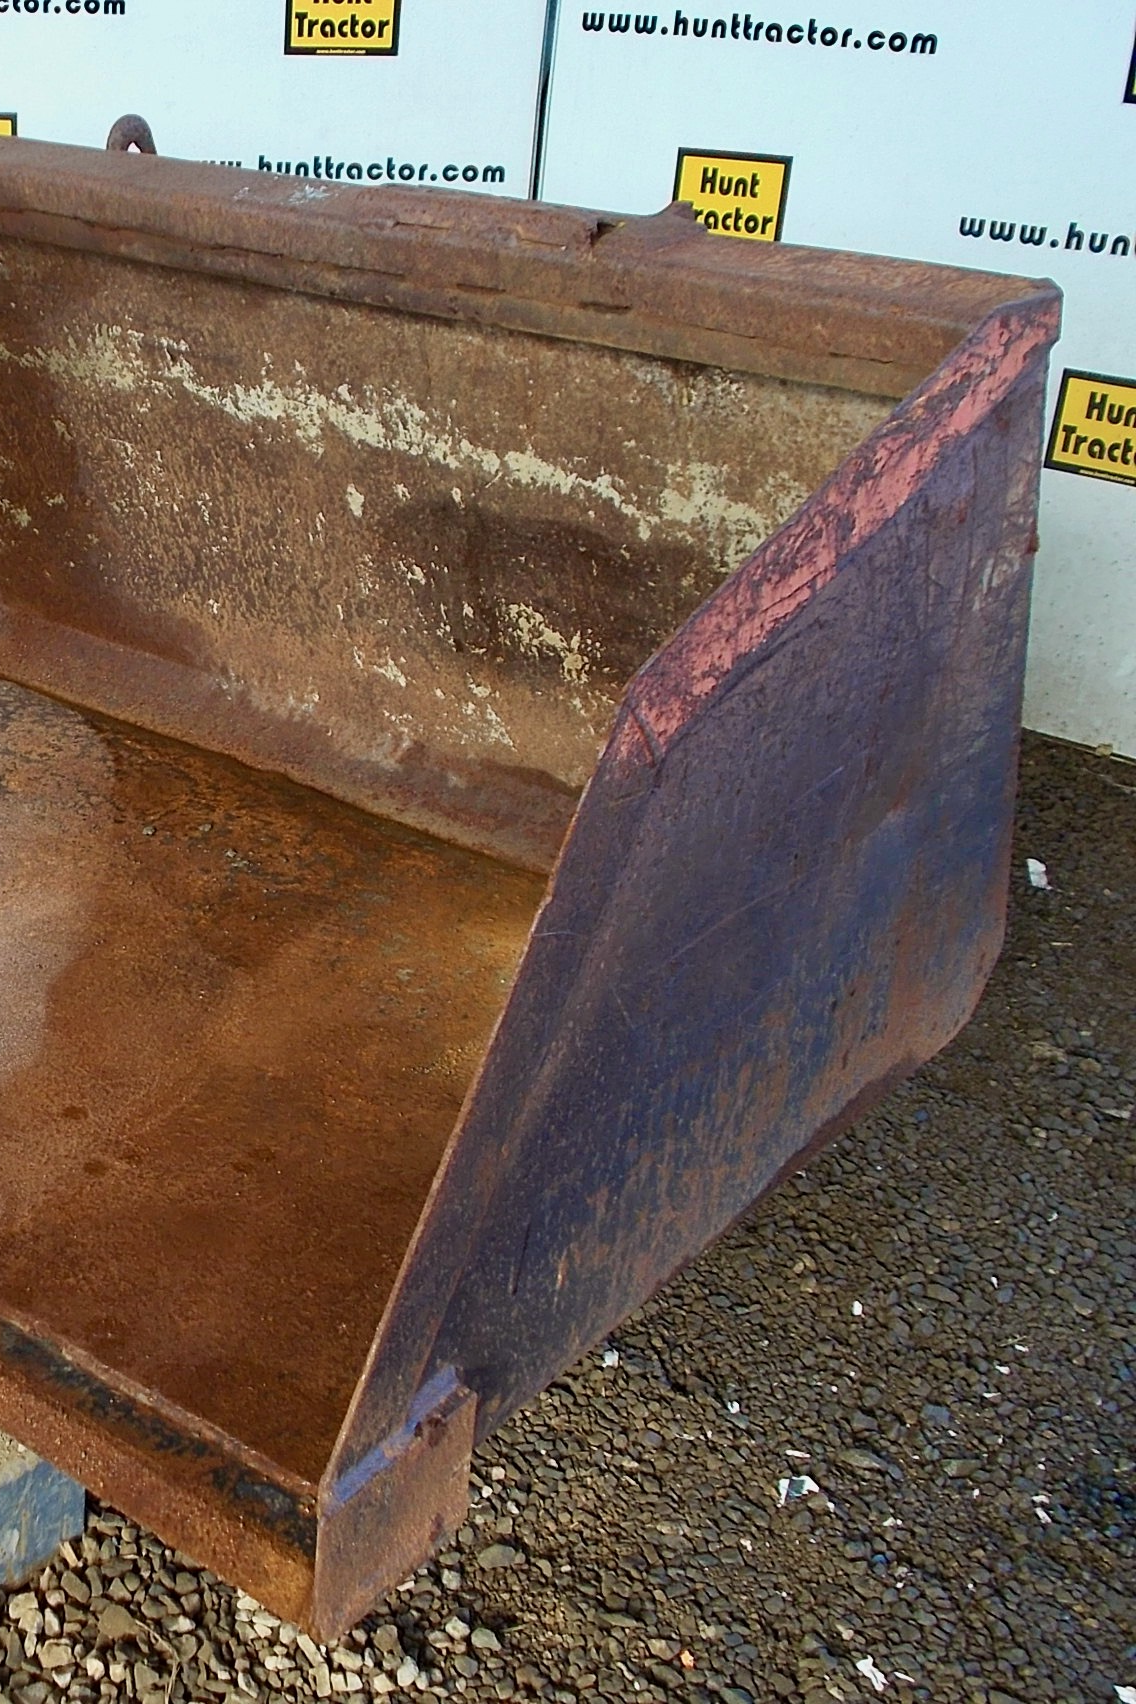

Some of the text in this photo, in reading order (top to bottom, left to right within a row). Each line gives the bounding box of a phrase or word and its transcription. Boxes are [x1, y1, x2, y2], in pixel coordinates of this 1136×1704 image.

[295, 12, 390, 38] Tractor
[582, 10, 938, 54] www.hunttractor.com
[700, 166, 760, 198] Hunt
[694, 206, 774, 235] ractor
[959, 216, 1136, 256] www.hun
[1061, 424, 1136, 466] Tract
